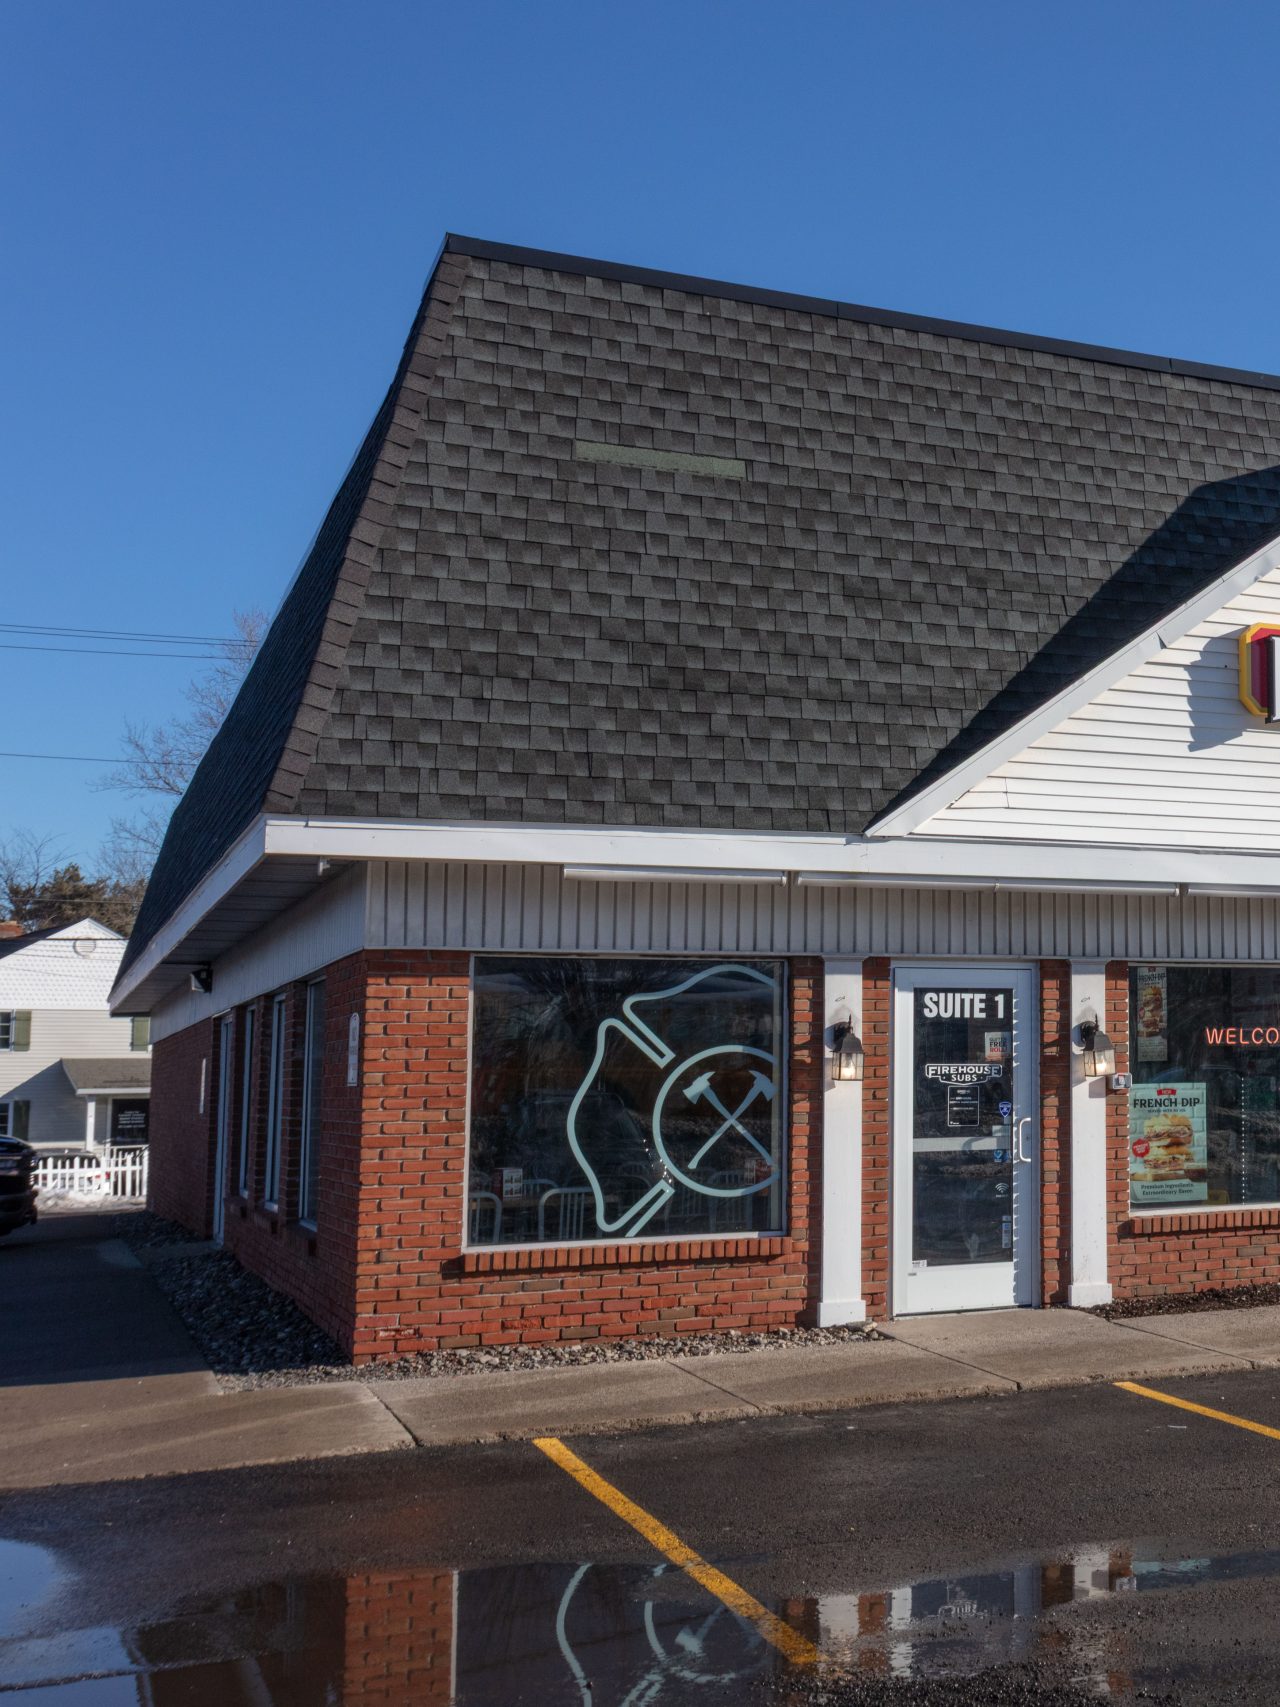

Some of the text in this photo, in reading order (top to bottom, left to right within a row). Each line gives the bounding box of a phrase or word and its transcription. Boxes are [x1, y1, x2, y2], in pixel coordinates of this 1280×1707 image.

[923, 992, 1005, 1019] SUITE 1
[928, 1066, 999, 1079] FIREHOUSE
[951, 1074, 978, 1082] SUBS
[1133, 1098, 1200, 1108] FRENCH DIP
